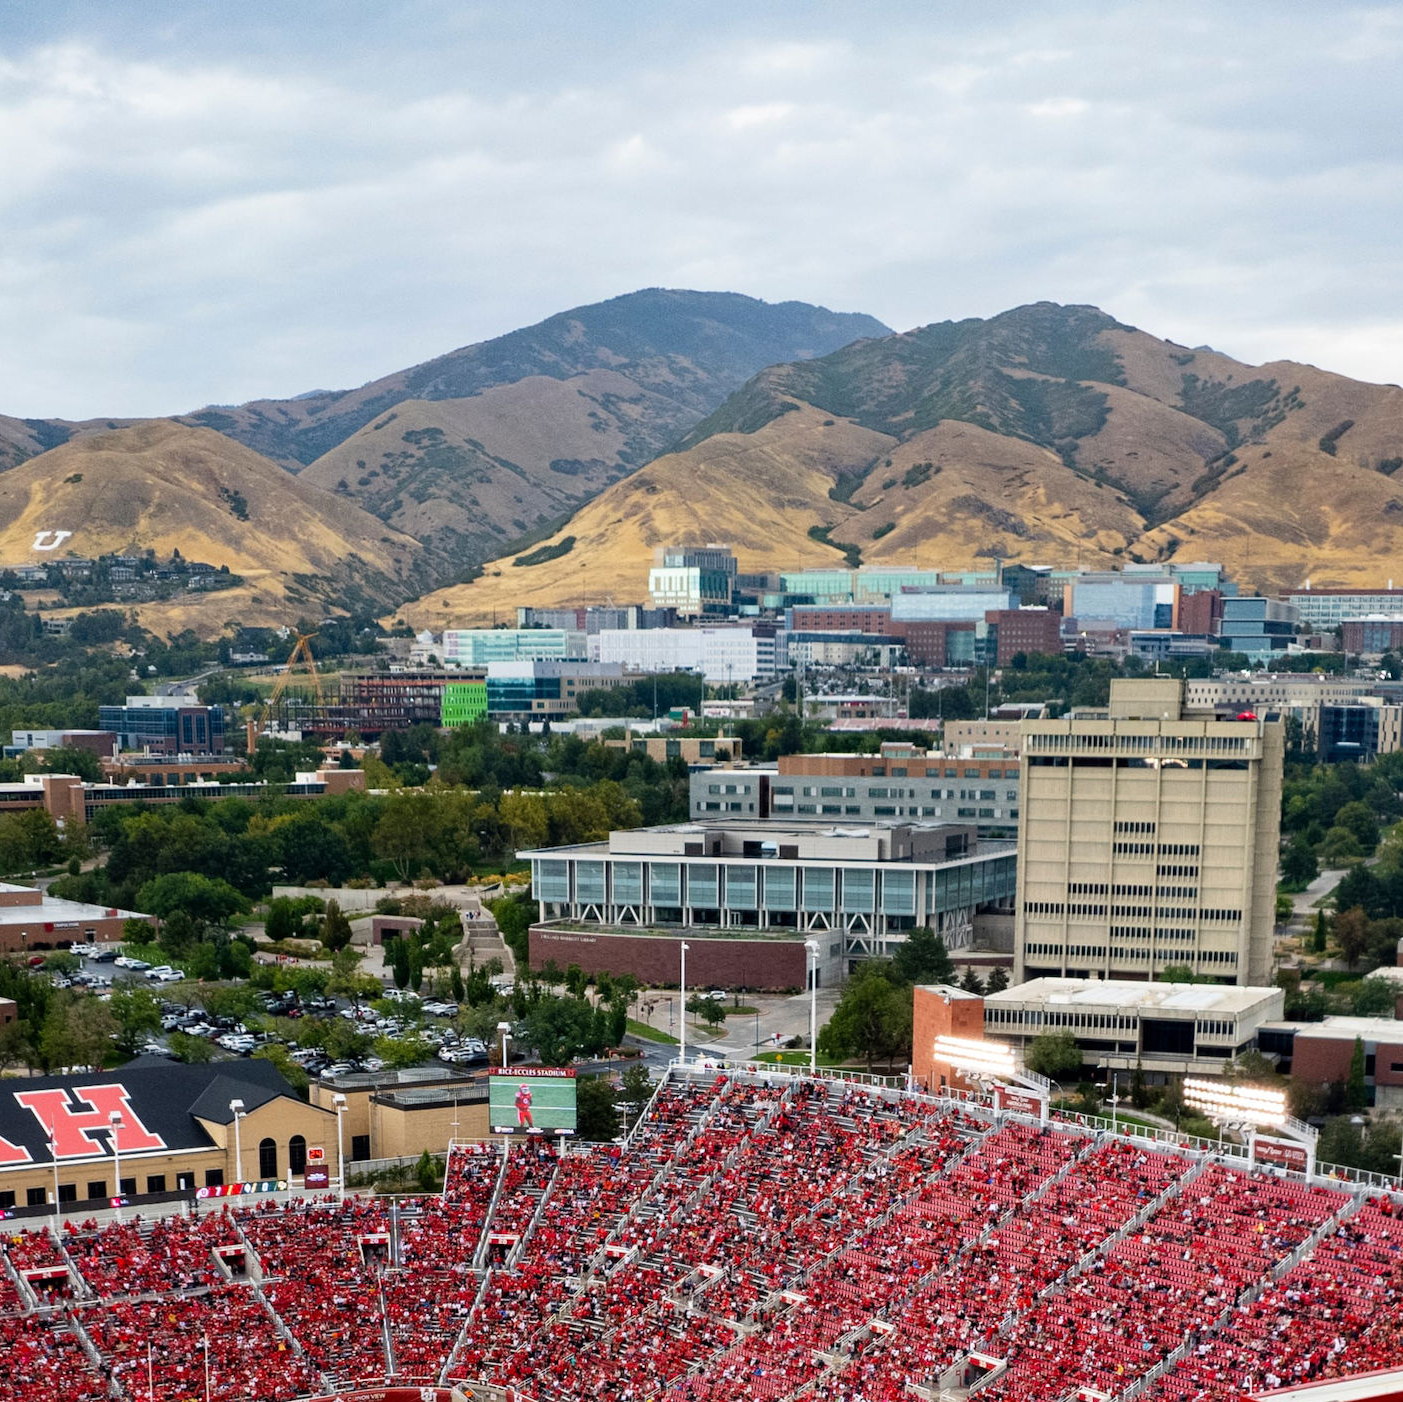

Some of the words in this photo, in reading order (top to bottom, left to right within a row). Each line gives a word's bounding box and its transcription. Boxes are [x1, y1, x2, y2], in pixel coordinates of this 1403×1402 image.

[31, 529, 73, 552] U
[498, 1068, 536, 1076] RICE-ECCLES
[537, 1069, 566, 1077] STADIUM
